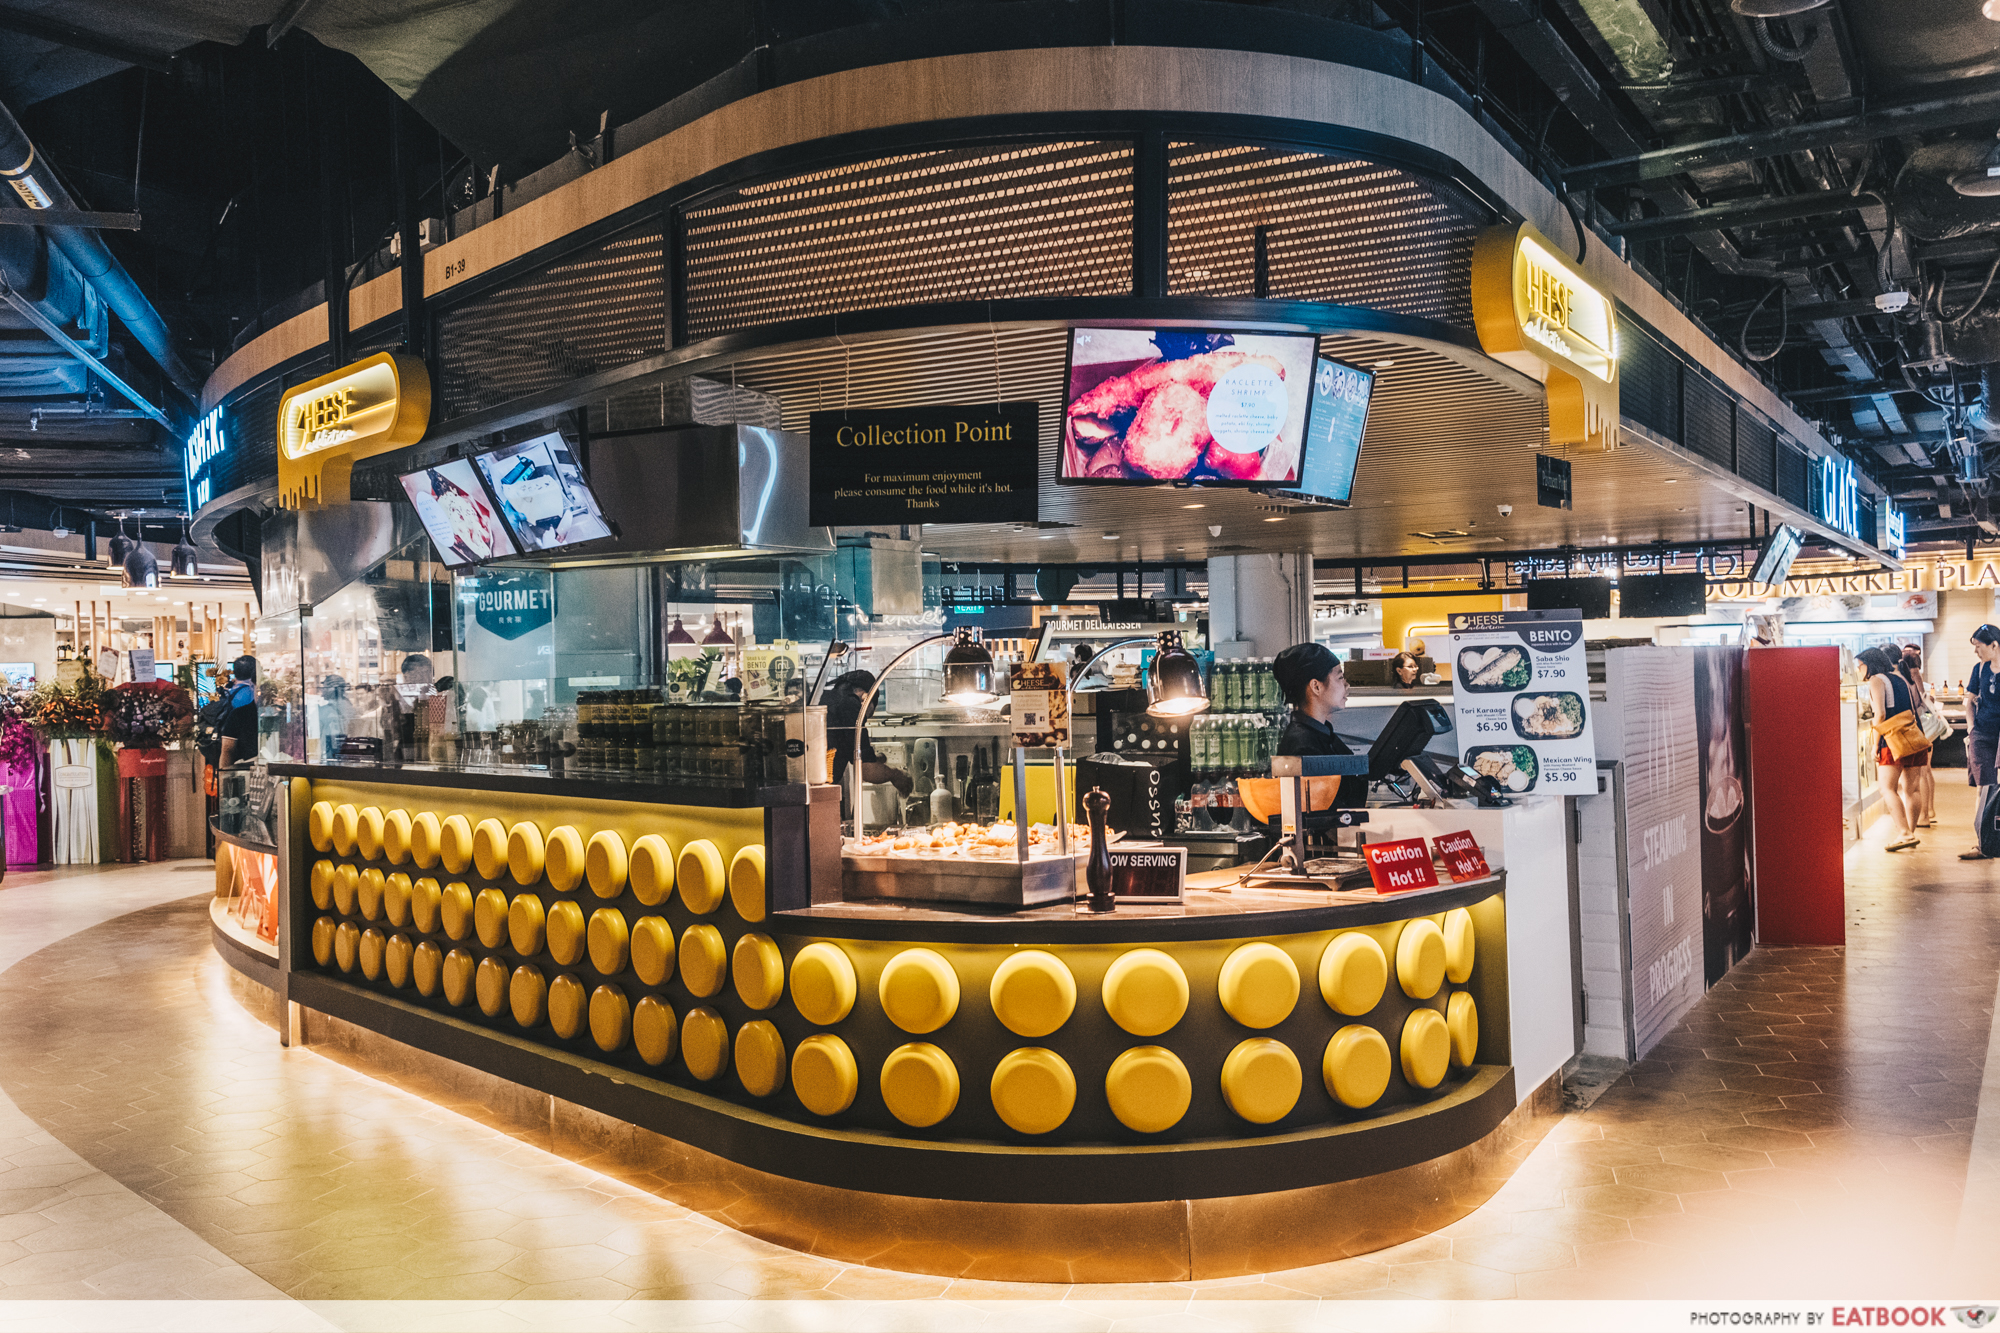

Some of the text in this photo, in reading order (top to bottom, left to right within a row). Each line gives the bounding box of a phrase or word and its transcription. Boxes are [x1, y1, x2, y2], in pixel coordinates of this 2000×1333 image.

[445, 258, 466, 280] B1-39
[1225, 379, 1274, 387] RACLETTE
[836, 419, 1013, 447] Collection Point
[864, 471, 982, 484] For maximum enjoyment
[834, 483, 1013, 499] please consume the food while it's hot.
[905, 498, 940, 509] Thanks
[1783, 567, 1925, 595] MARKET
[479, 589, 549, 612] GOURMET
[1046, 619, 1083, 631] OURMET
[1529, 629, 1572, 642] BENTO
[784, 640, 790, 650] 6
[747, 661, 767, 669] BENTO
[1537, 669, 1566, 679] $7.90
[1476, 721, 1508, 732] $6.90
[1573, 756, 1592, 764] Wing
[1545, 771, 1577, 783] $5.90
[1440, 837, 1474, 854] Caution
[1643, 813, 1687, 872] STEAMING
[1111, 855, 1177, 867] OW SERVING
[1371, 845, 1424, 864] Caution
[1455, 858, 1474, 875] Hot
[1388, 867, 1426, 887] Hot !!
[1663, 884, 1674, 927] IN
[1650, 934, 1692, 1006] PROGRESS
